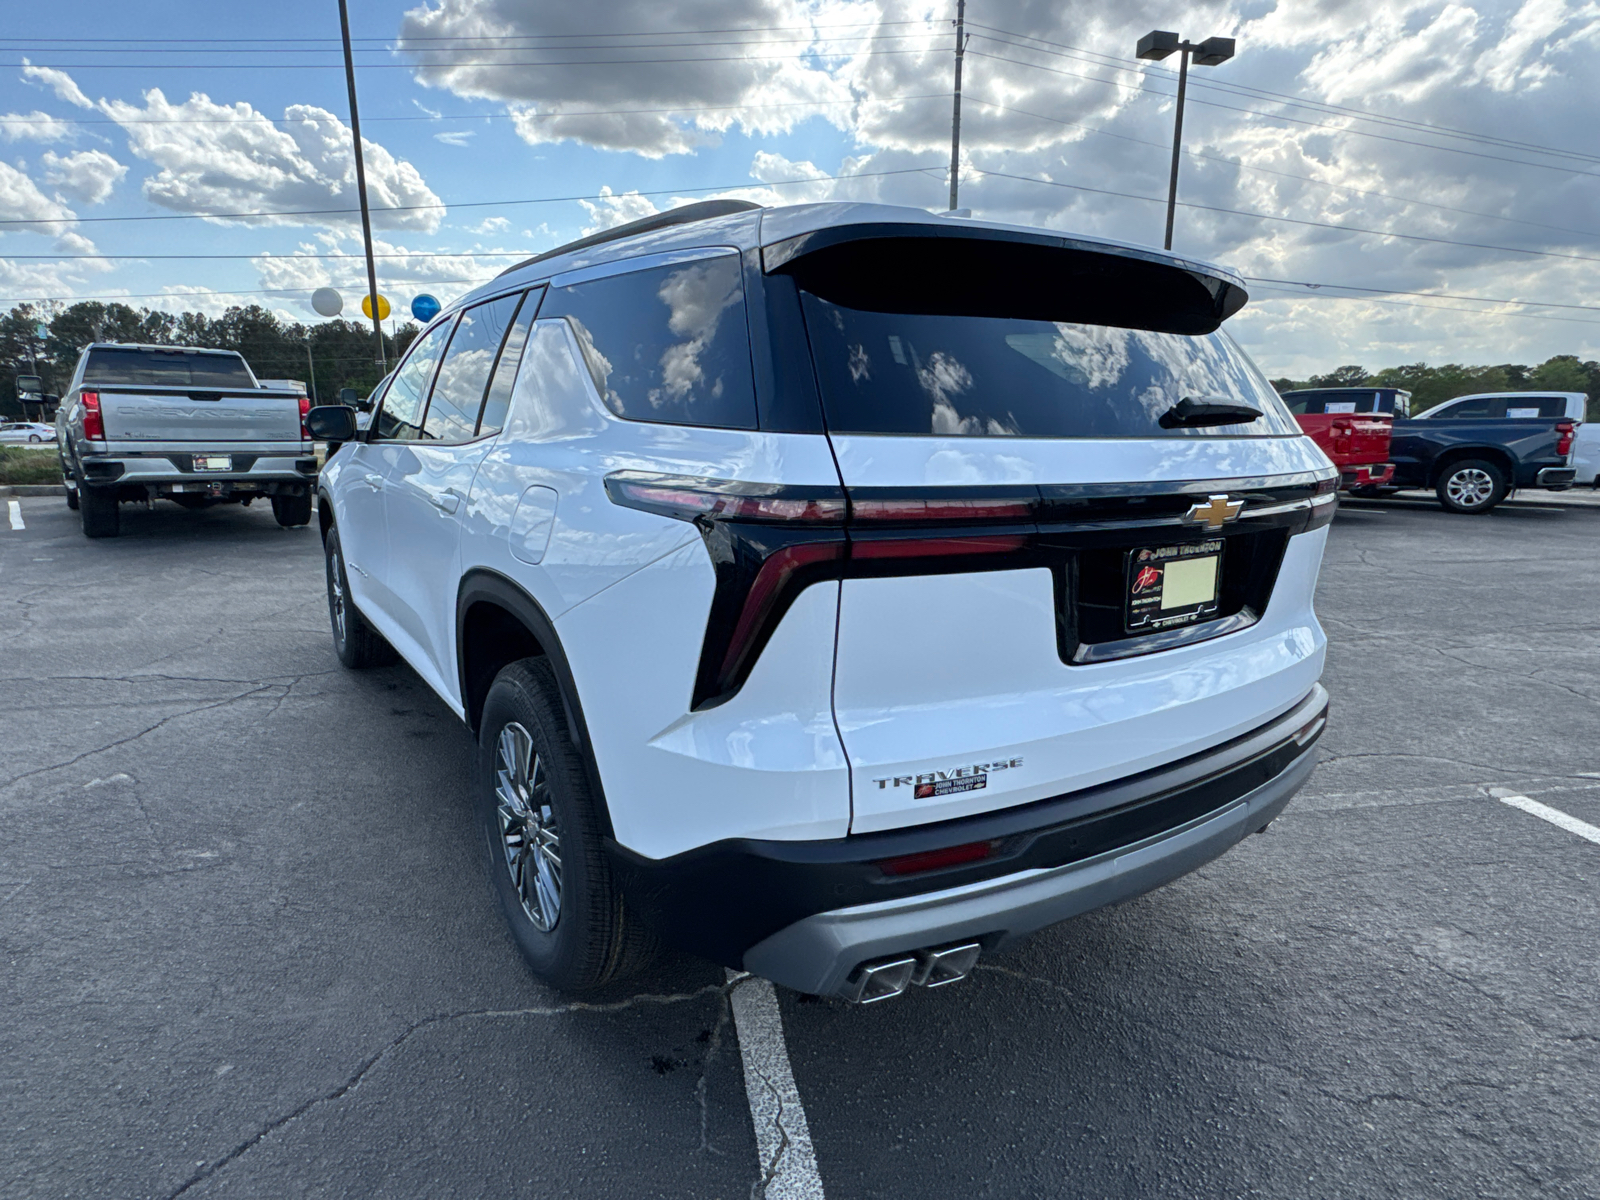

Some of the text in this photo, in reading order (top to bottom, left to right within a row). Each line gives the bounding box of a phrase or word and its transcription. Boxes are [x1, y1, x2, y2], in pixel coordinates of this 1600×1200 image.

[1155, 547, 1178, 559] JOHN
[1162, 616, 1189, 626] CHEVROLET
[872, 757, 1024, 789] TRAVERSE
[935, 775, 985, 790] JOHN THORNTON
[935, 784, 973, 795] CHEVROLET
